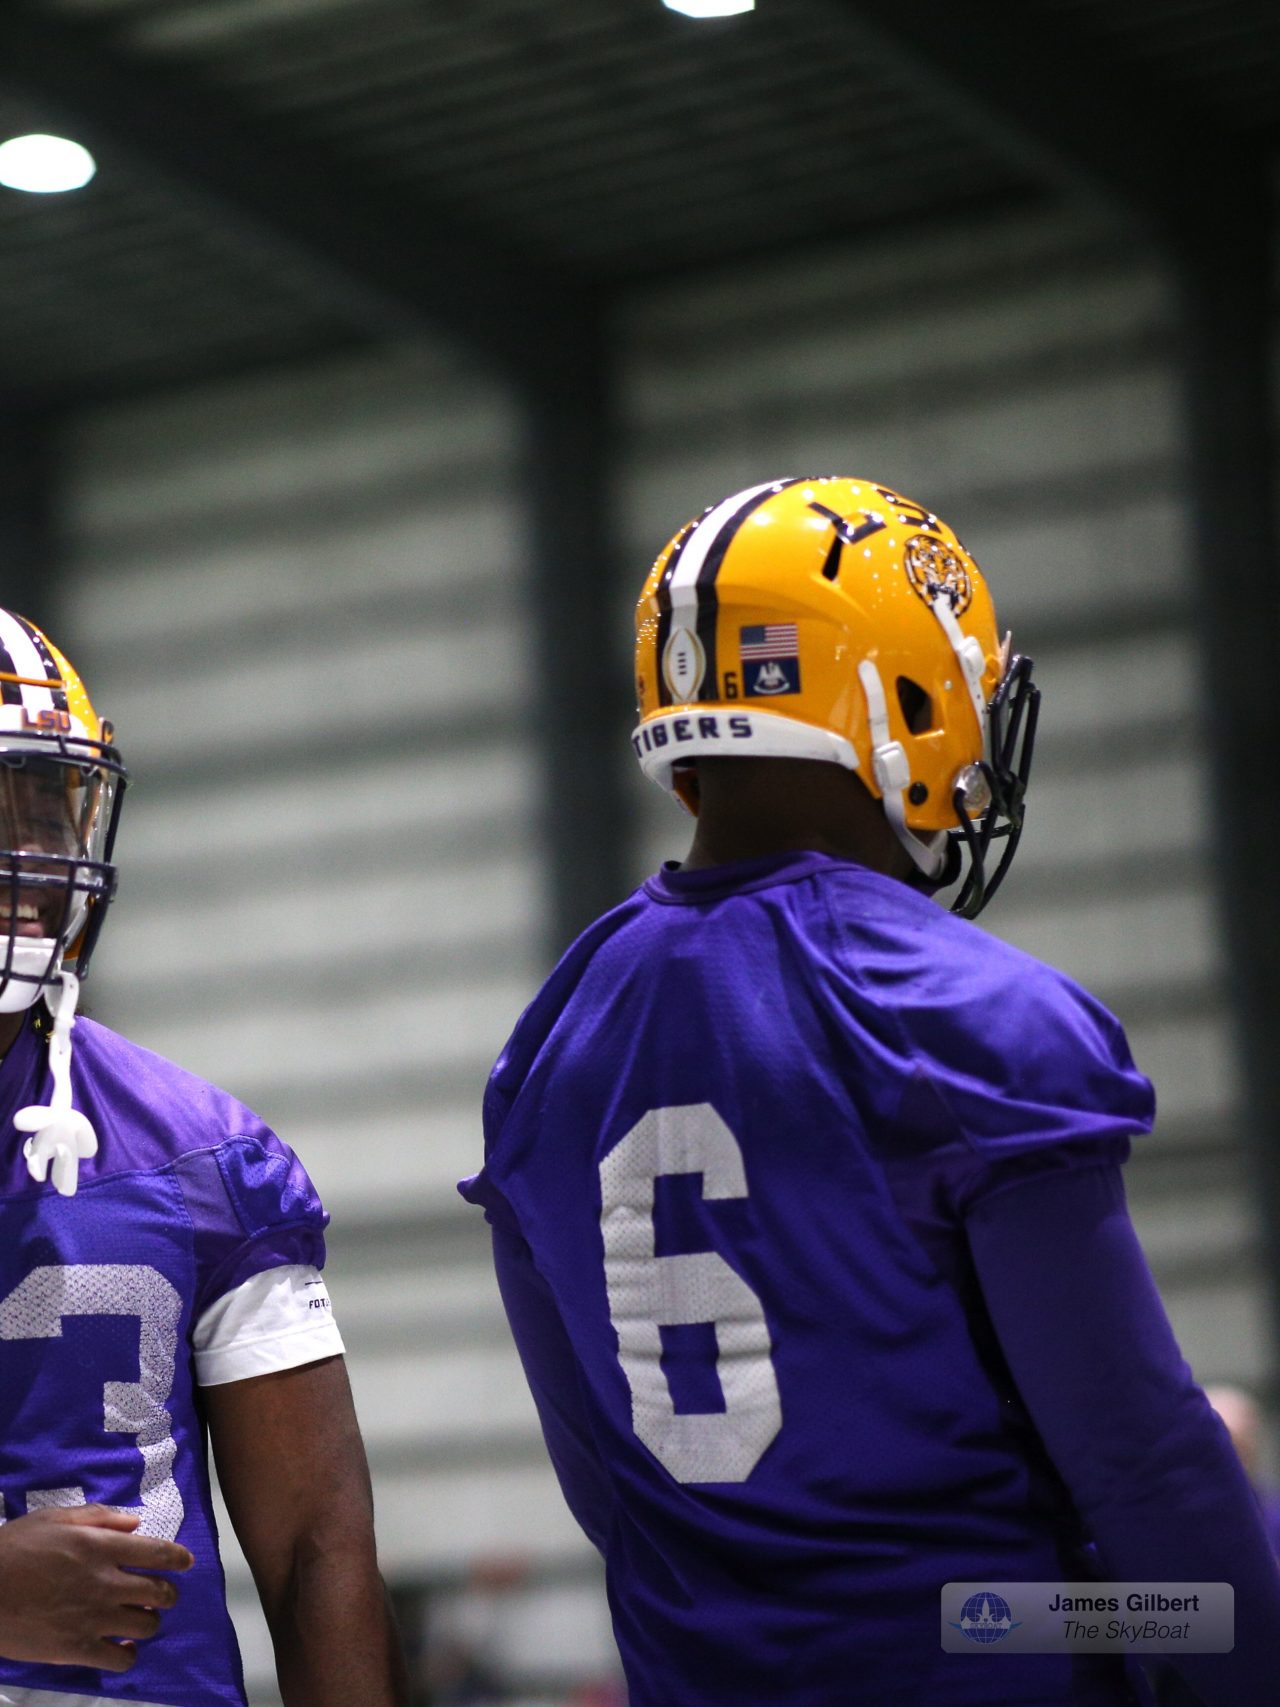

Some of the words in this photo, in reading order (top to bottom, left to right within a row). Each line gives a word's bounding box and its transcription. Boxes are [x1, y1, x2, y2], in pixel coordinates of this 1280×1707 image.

[724, 672, 738, 700] 6
[21, 707, 72, 733] LSU
[632, 716, 753, 758] TIGERS
[599, 1102, 783, 1483] 6
